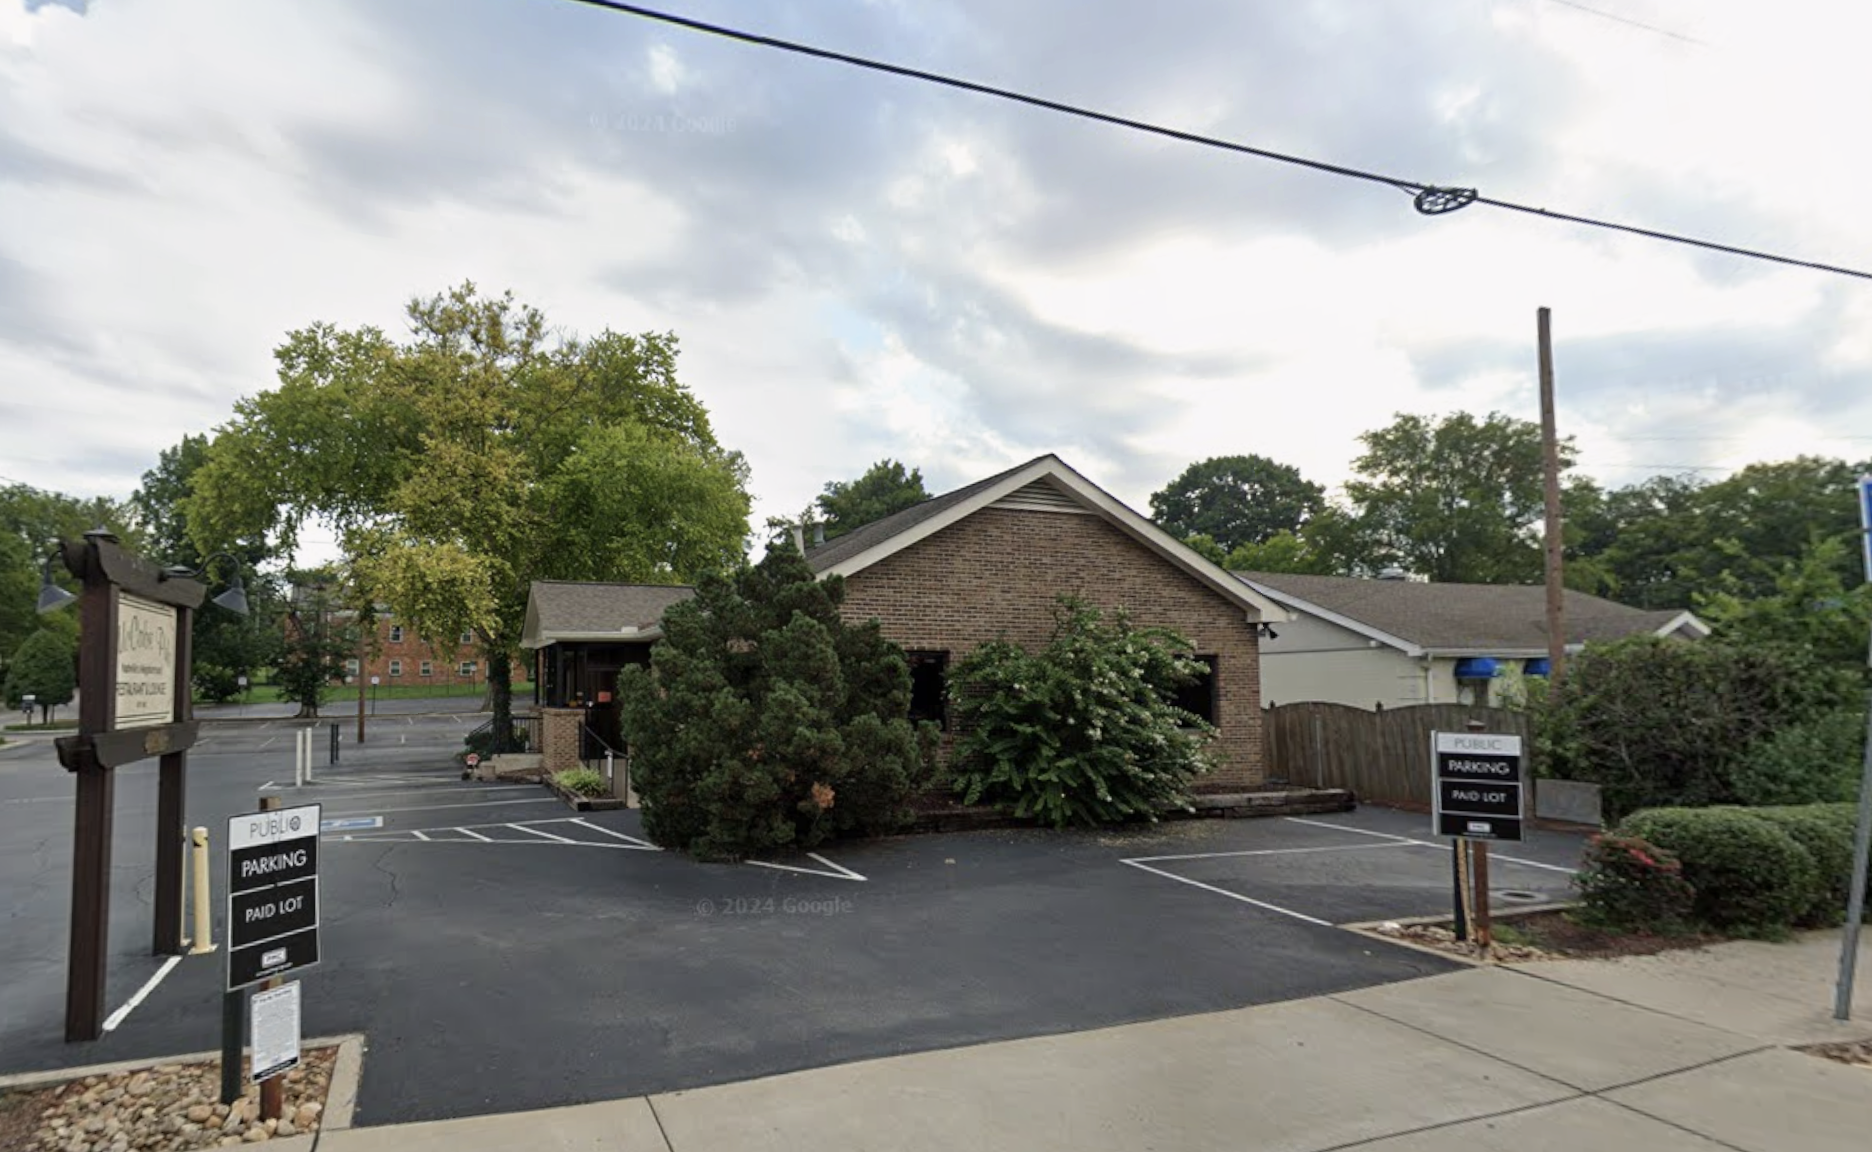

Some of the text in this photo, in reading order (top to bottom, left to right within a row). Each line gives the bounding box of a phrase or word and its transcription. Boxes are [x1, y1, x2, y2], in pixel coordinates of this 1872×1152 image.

[1454, 738, 1503, 750] PUBLIC
[1448, 759, 1510, 775] PARKING
[1452, 789, 1507, 803] PAID LOT
[241, 849, 307, 878] PARKING
[246, 896, 303, 923] PAID LOT
